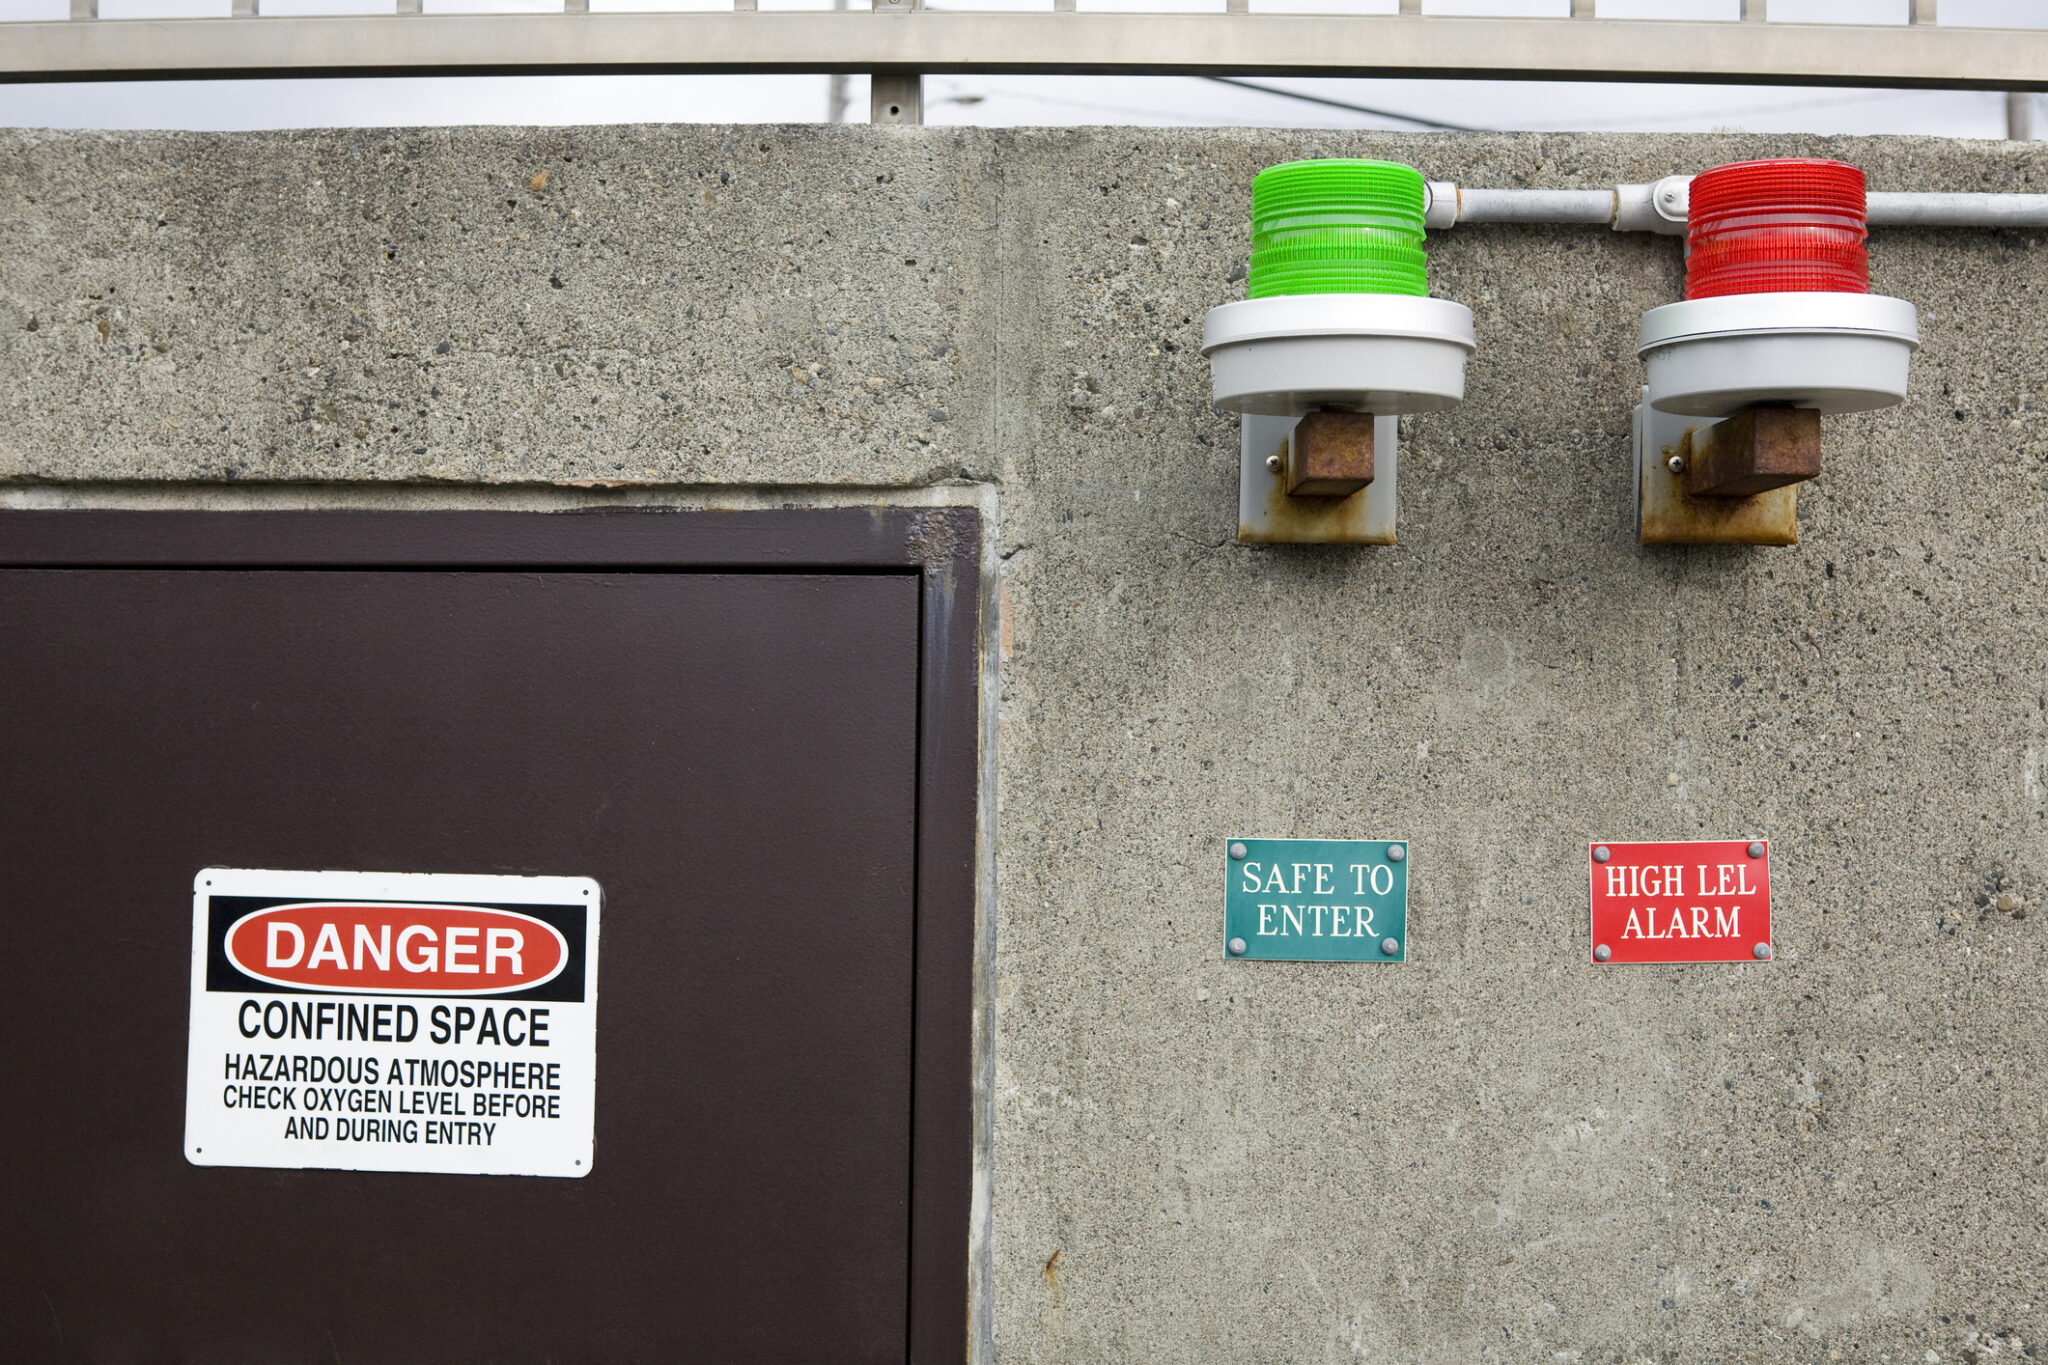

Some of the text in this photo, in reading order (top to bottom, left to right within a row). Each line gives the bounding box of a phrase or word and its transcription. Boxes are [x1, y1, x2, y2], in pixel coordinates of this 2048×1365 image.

[1242, 863, 1394, 895] SAFE TO
[1606, 864, 1756, 897] HIGH LEL
[1257, 905, 1379, 937] ENTER
[1621, 906, 1741, 939] ALARM
[266, 922, 524, 975] DANGER
[238, 1000, 550, 1046] CONFINED SPACE
[225, 1053, 560, 1090] HAZARDOUS ATMOSPHERE
[223, 1085, 560, 1118] CHECK OXYGEN LEVEL BEFORE
[285, 1117, 497, 1146] AND DURING ENTRY
